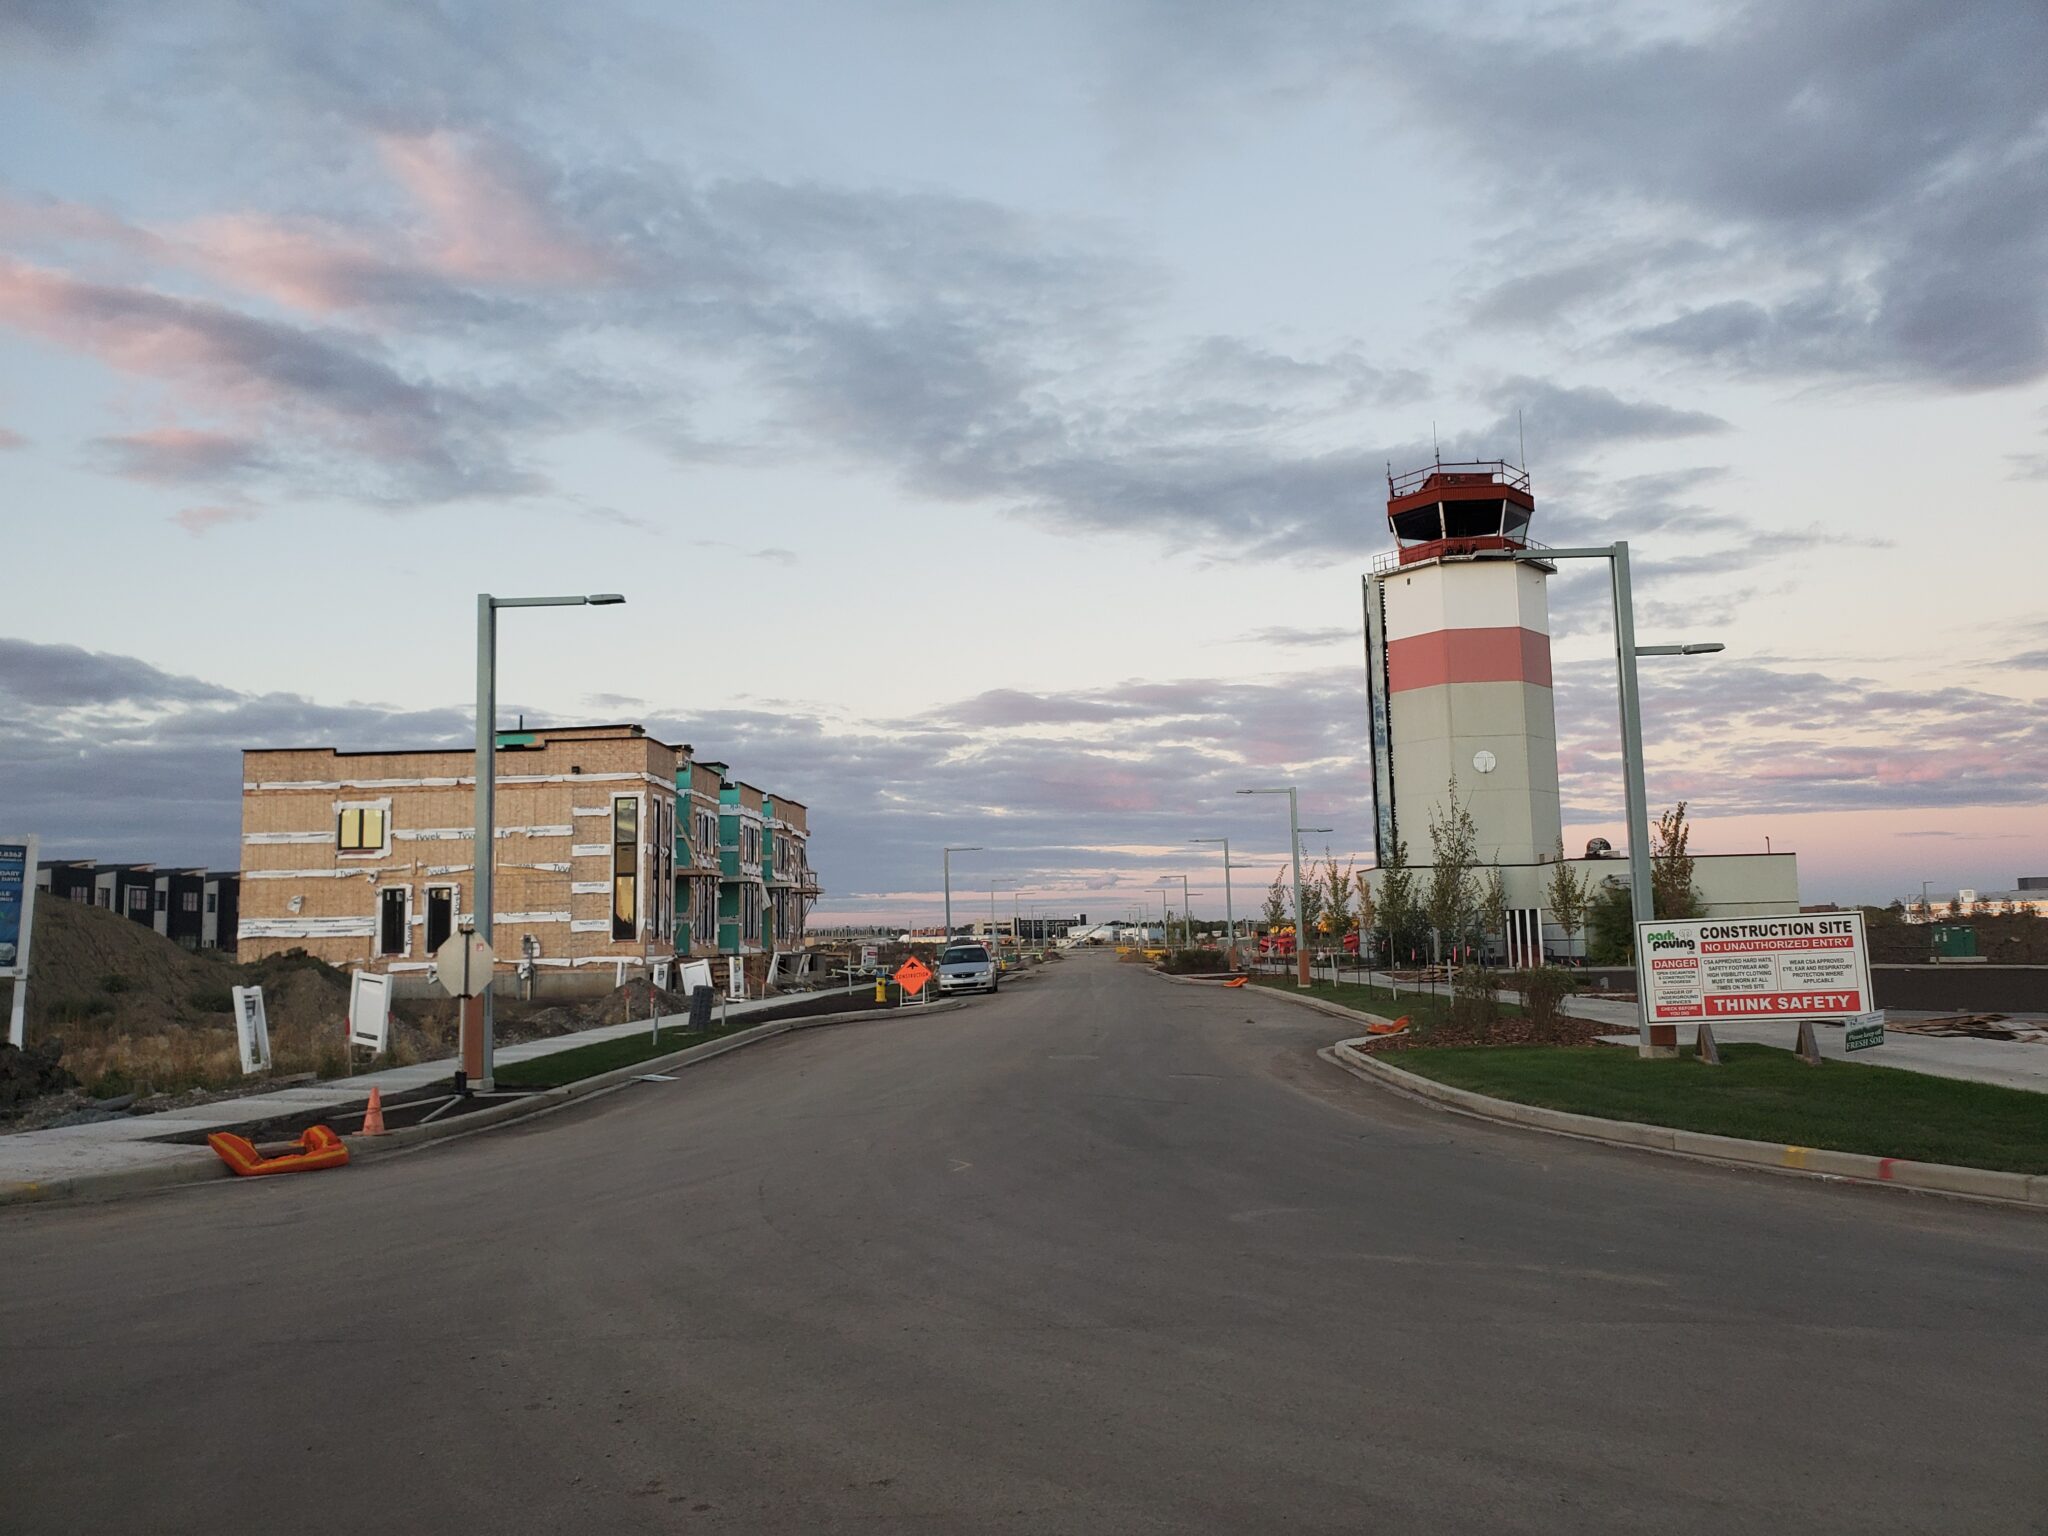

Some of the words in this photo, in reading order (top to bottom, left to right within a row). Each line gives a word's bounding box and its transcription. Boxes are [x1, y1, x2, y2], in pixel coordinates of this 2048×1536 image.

[416, 833, 440, 841] Tyvek
[1647, 930, 1675, 943] park
[1700, 924, 1814, 939] CONSTRUCTION
[1819, 921, 1852, 934] SITE
[1653, 938, 1695, 951] paving
[1705, 943, 1721, 952] NO
[1723, 940, 1809, 951] UNAUTHORIZED
[1812, 937, 1850, 948] ENTRY
[1654, 959, 1697, 969] DANGER
[1715, 957, 1742, 965] APPROVED
[1713, 997, 1772, 1012] THINK
[1777, 995, 1850, 1010] SAFETY
[1846, 1038, 1869, 1050] FRESH
[1869, 1035, 1884, 1045] SOD
